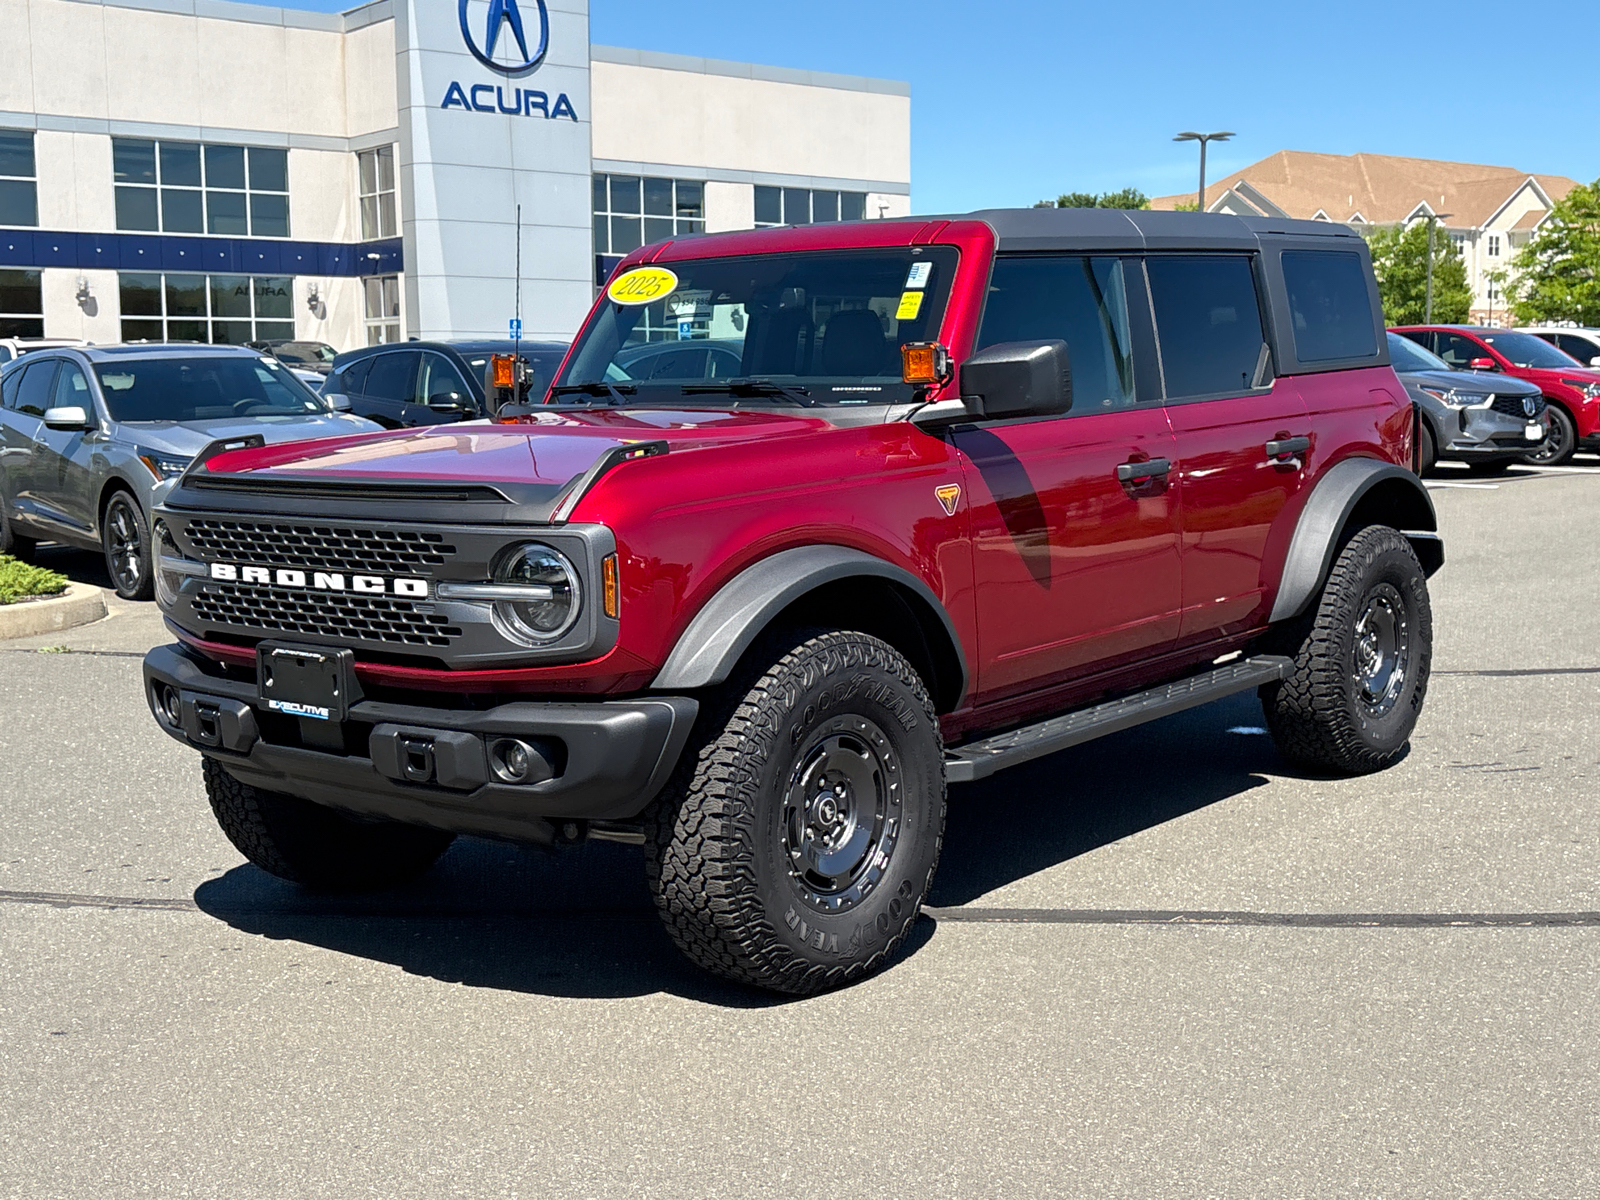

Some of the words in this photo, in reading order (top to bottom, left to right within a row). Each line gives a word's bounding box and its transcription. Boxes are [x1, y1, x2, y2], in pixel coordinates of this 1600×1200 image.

[440, 81, 578, 122] ACURA
[615, 276, 669, 296] 2025
[210, 562, 428, 597] BRONCO
[268, 700, 329, 717] EXECUTIVE
